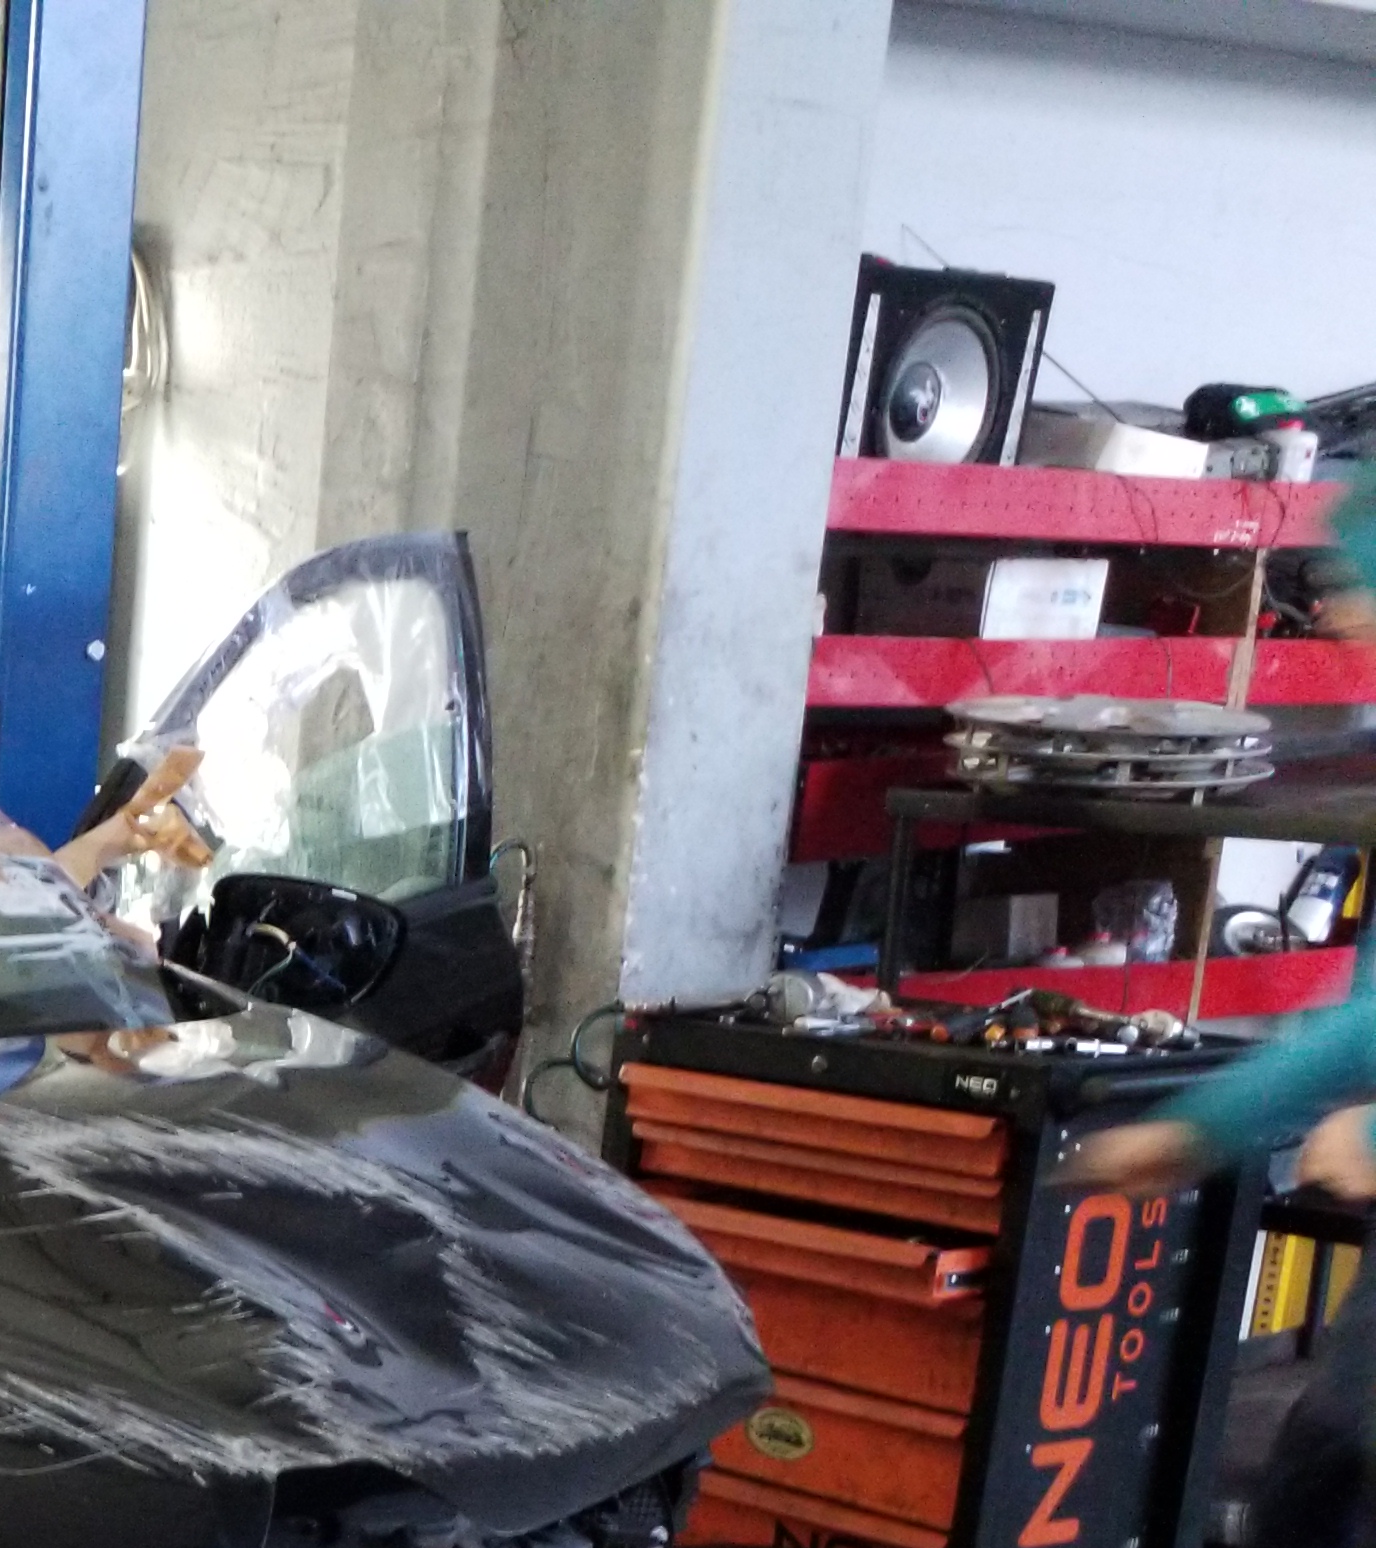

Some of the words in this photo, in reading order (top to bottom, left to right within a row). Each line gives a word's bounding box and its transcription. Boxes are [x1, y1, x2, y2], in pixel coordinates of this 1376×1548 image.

[955, 1074, 998, 1094] NEO
[1017, 1193, 1132, 1548] NEO
[1111, 1197, 1168, 1401] TOOLS
